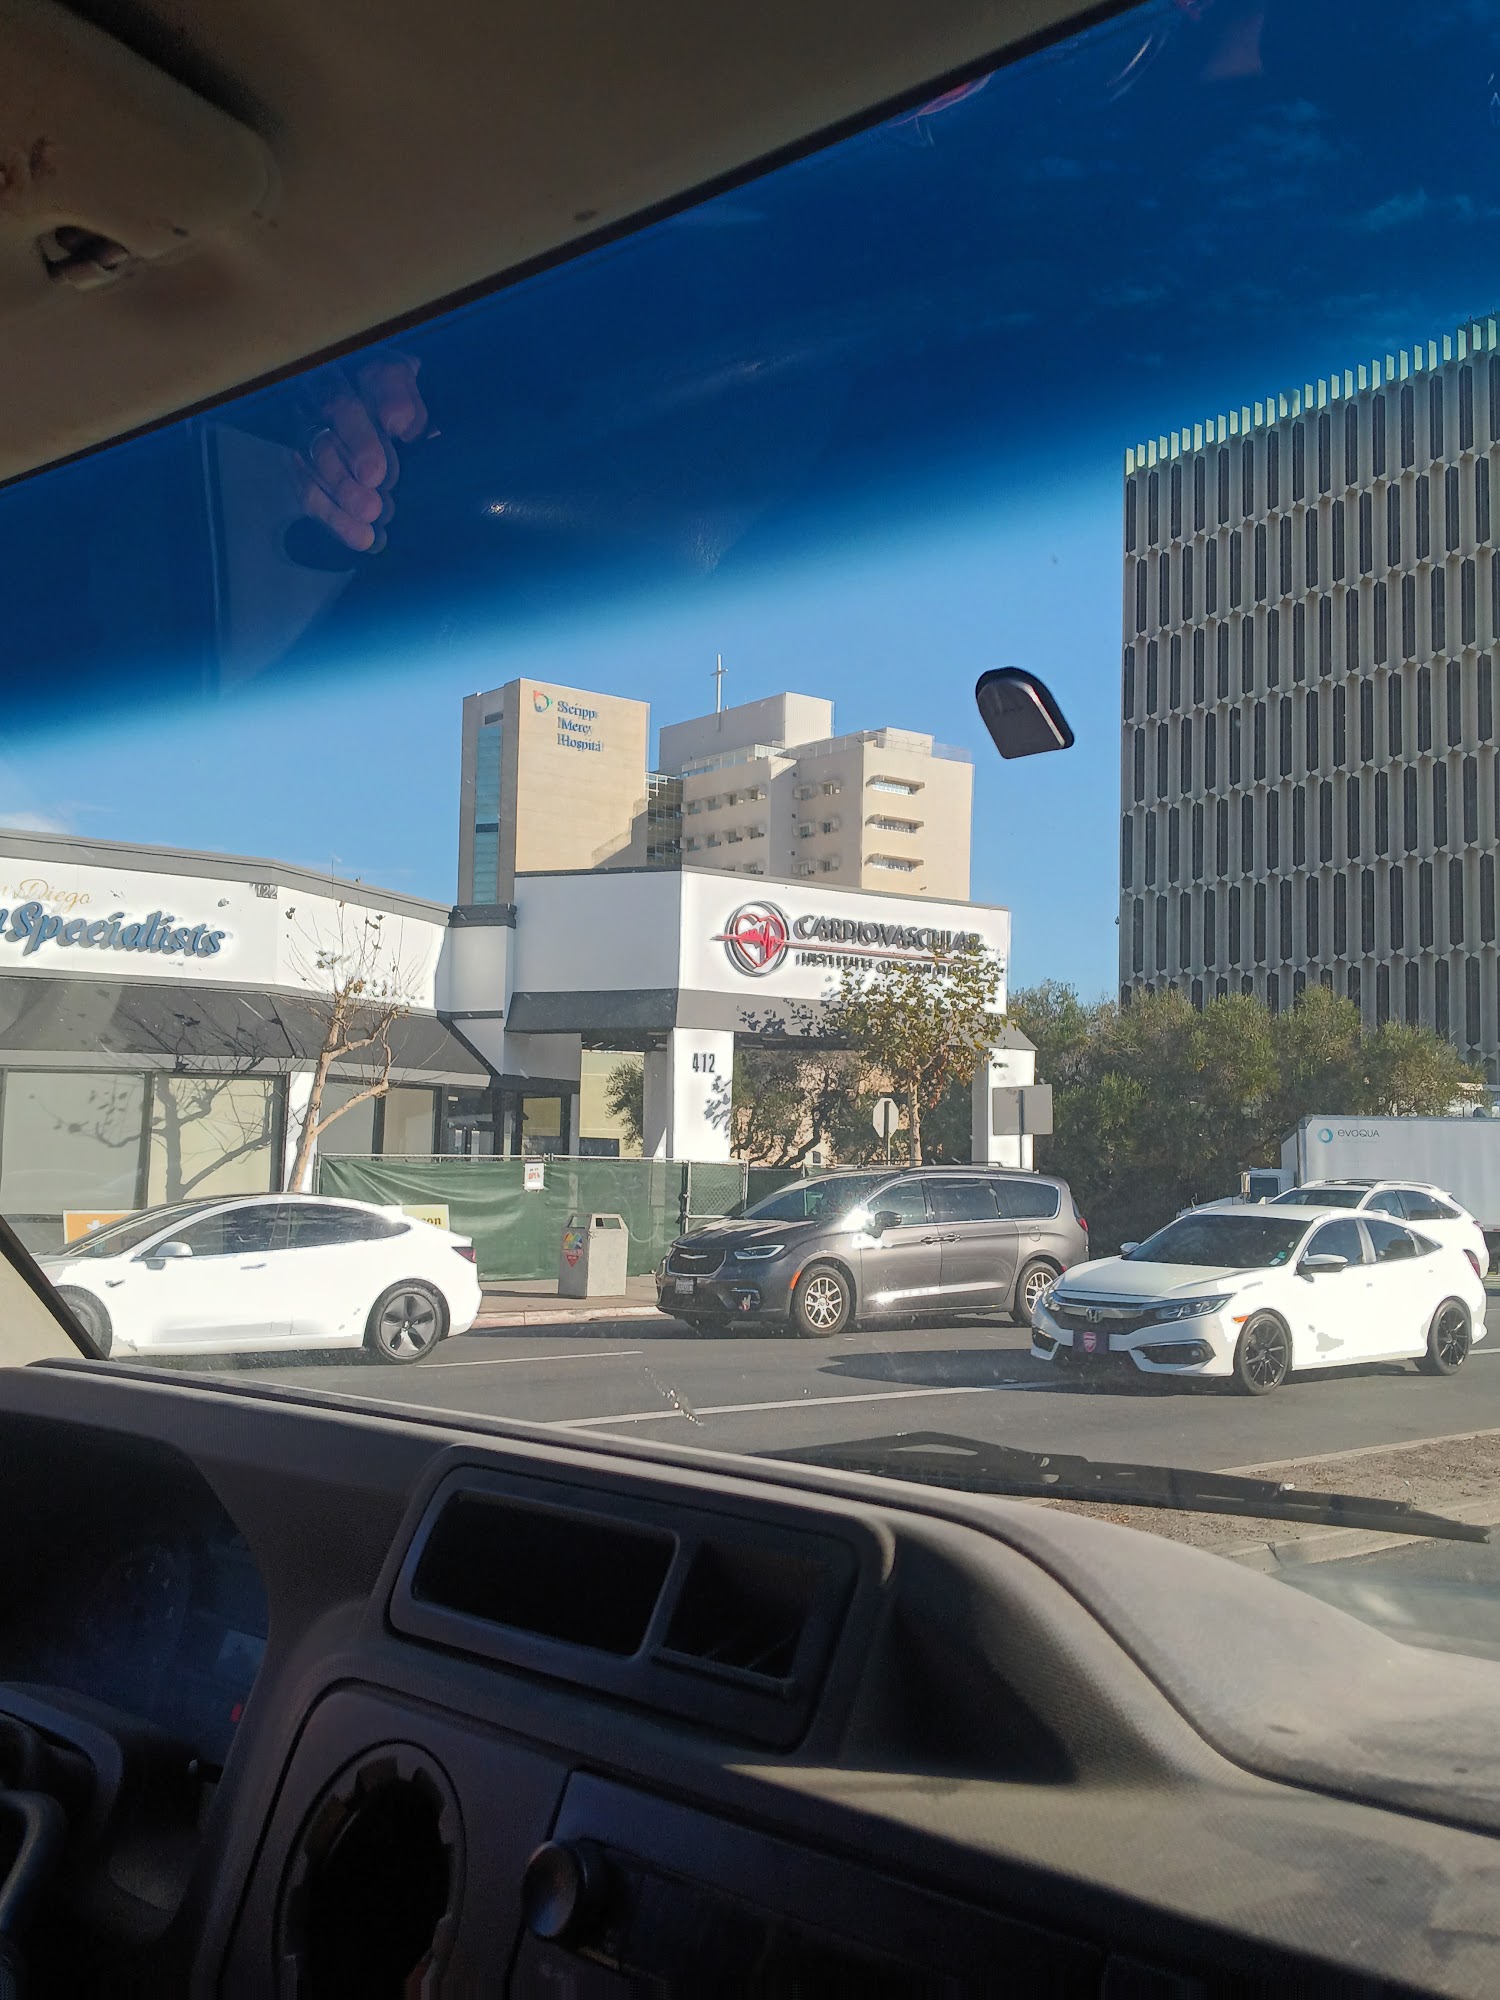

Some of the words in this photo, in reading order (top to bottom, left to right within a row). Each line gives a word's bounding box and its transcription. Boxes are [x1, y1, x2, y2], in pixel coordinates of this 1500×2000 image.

[14, 879, 91, 913] Diego
[5, 901, 226, 958] Specialists
[693, 1053, 715, 1073] 412
